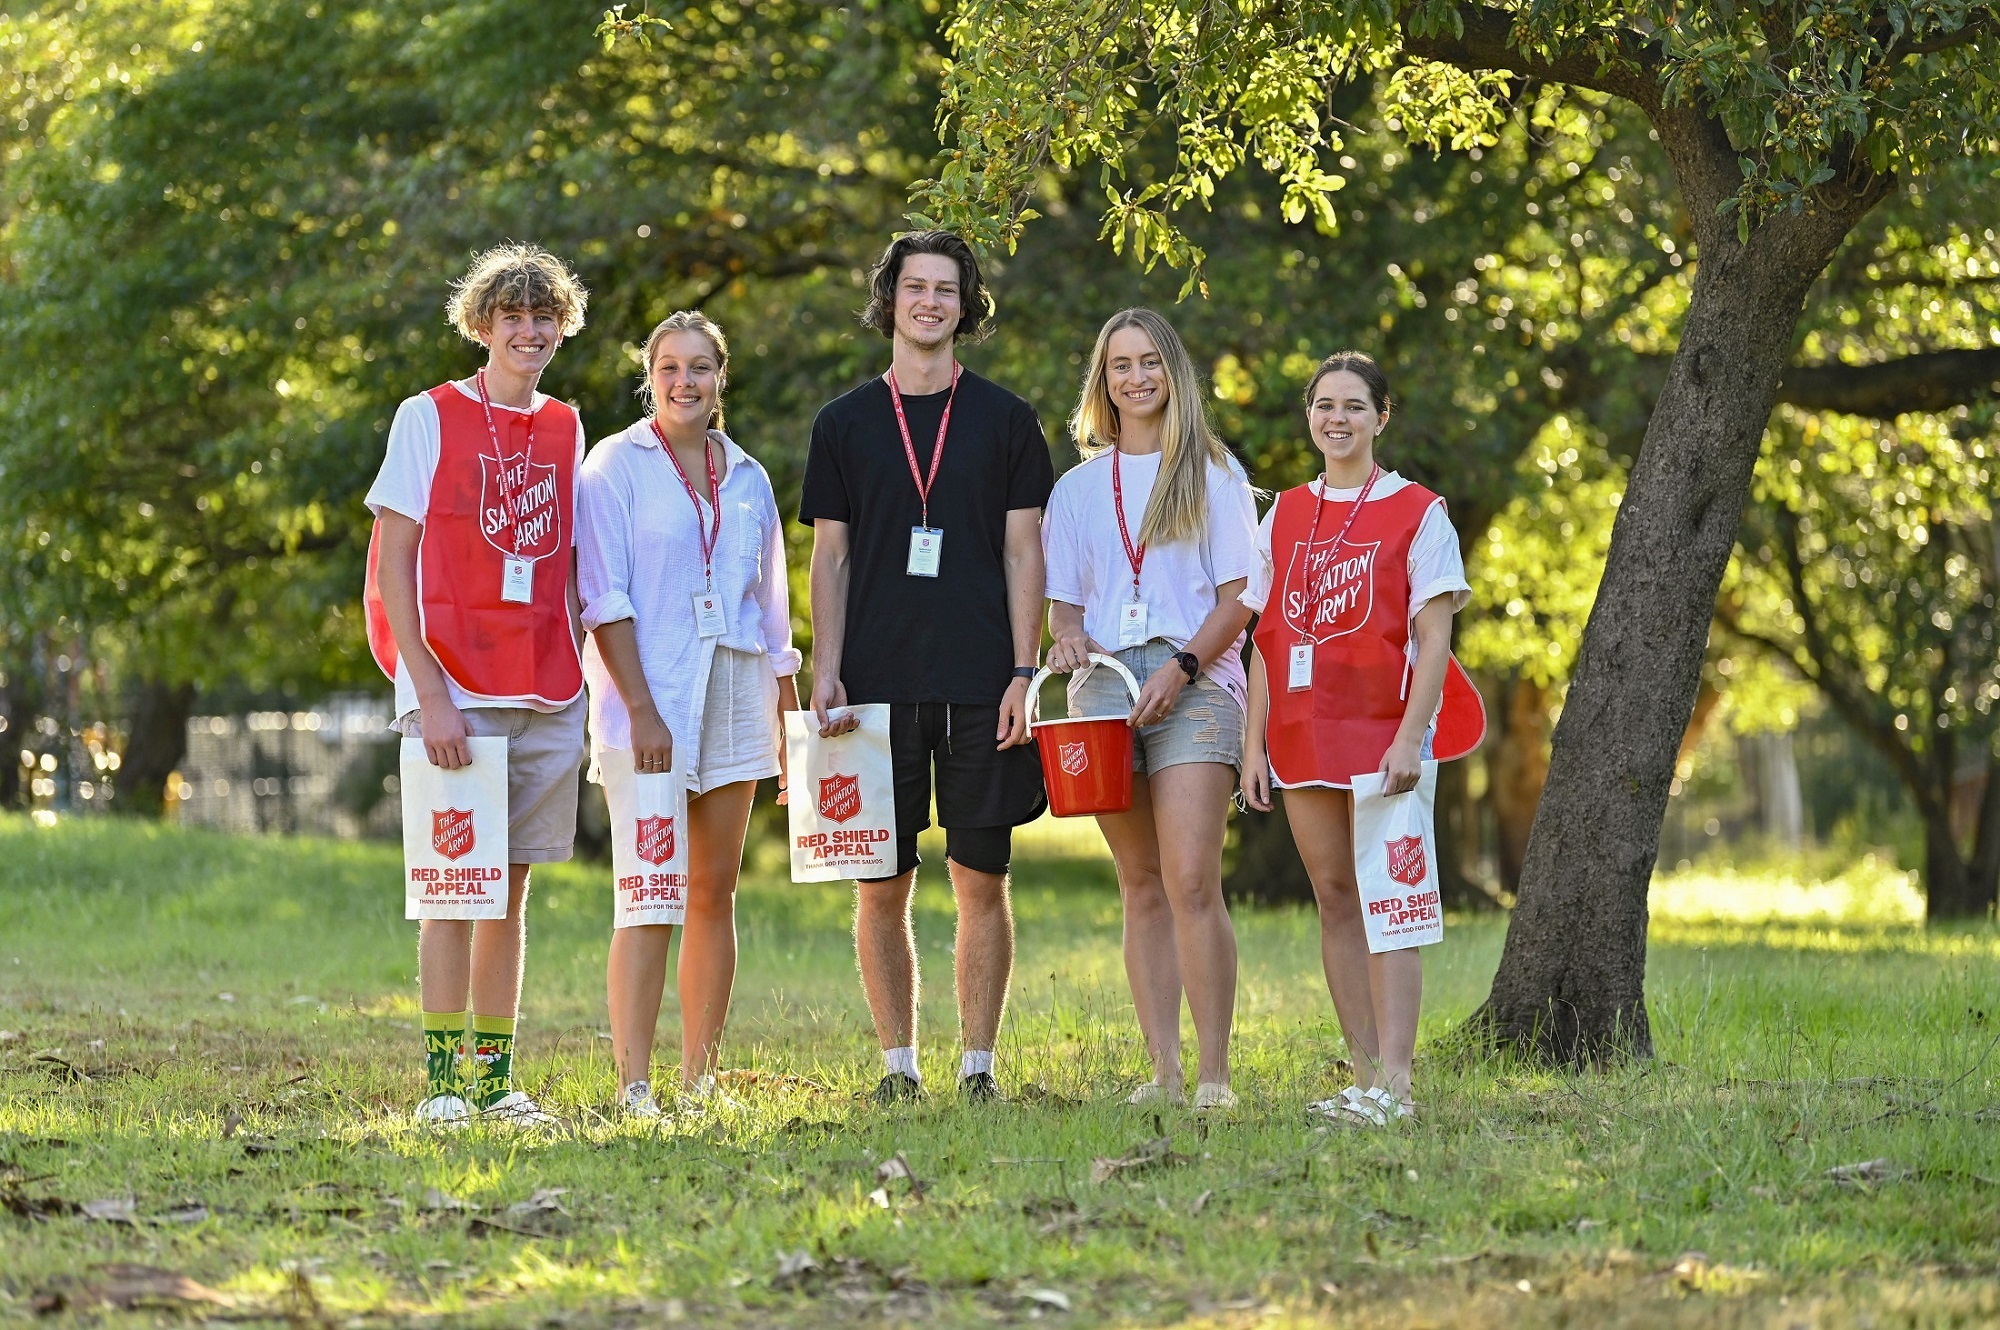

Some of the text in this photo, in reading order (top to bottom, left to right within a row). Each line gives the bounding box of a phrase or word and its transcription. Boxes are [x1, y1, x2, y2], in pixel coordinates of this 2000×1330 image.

[515, 505, 553, 548] ARMY
[1312, 580, 1362, 632] ARMY
[825, 778, 841, 795] THE
[821, 780, 856, 814] SALVATION
[835, 795, 856, 818] ARMY
[439, 812, 455, 830] THE
[643, 819, 659, 837] THE
[434, 815, 470, 848] SALVATION
[797, 829, 890, 848] RED SHIELD
[447, 830, 470, 855] ARMY
[652, 837, 672, 861] ARMY
[813, 844, 874, 859] APPEAL
[1394, 839, 1411, 858] THE
[411, 868, 502, 881] RED SHIELD
[1407, 858, 1424, 882] ARMY
[425, 882, 486, 895] APPEAL
[619, 874, 687, 891] RED SHIELD
[632, 888, 680, 902] APPEAL
[1368, 898, 1402, 916] RED
[1388, 906, 1436, 926] APPEAL
[1415, 924, 1426, 932] FOR
